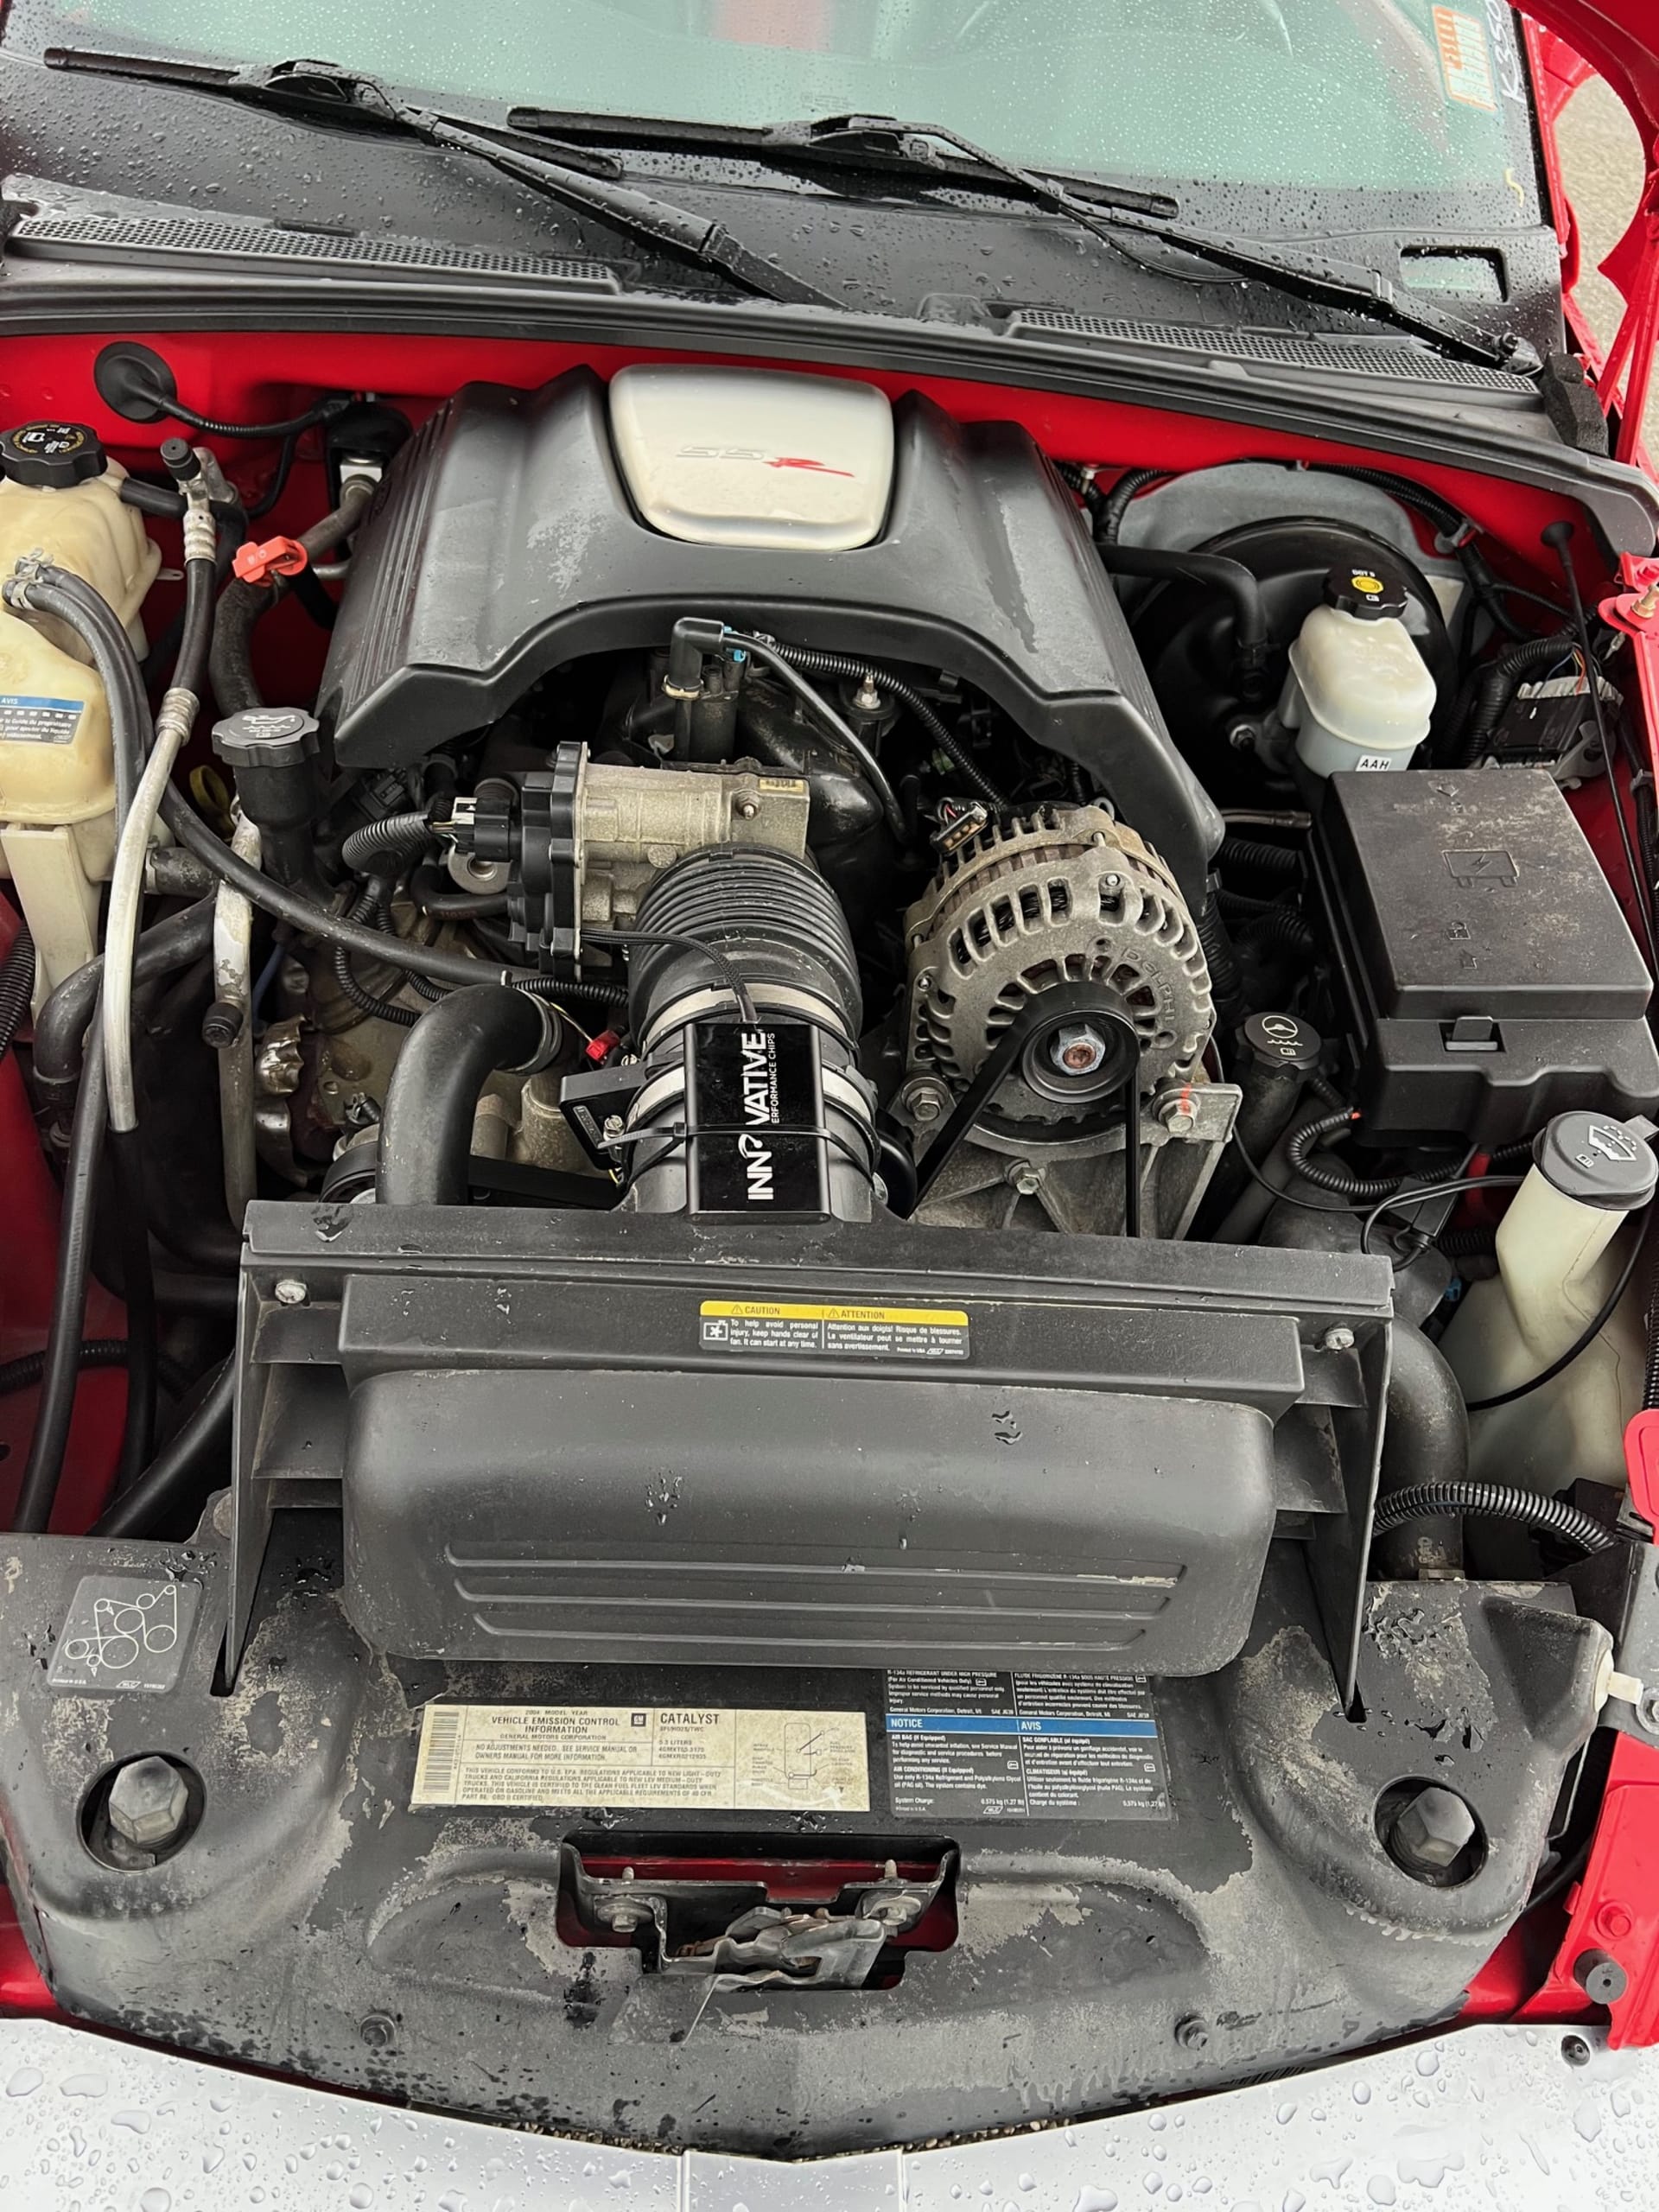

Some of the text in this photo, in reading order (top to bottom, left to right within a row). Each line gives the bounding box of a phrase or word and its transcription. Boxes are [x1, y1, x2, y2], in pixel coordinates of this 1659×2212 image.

[1360, 759, 1389, 770] AAH
[767, 1033, 779, 1124] ERFORMANCE CHIPS
[745, 1306, 780, 1315] CAUTION
[841, 1310, 885, 1319] ATTENTION
[744, 1319, 760, 1329] help
[790, 1322, 818, 1331] personal
[827, 1323, 855, 1332] Attention
[872, 1325, 893, 1333] doigts!
[895, 1325, 918, 1335] Risque
[930, 1327, 962, 1336] blessures.
[752, 1329, 768, 1338] keep
[800, 1340, 817, 1349] time.
[844, 1343, 891, 1351] avertissement.
[531, 1717, 575, 1726] EMISSION
[579, 1718, 620, 1726] CONTROL
[660, 1713, 720, 1725] CATALYST
[891, 1719, 923, 1728] NOTICE
[1021, 1721, 1042, 1731] AVIS
